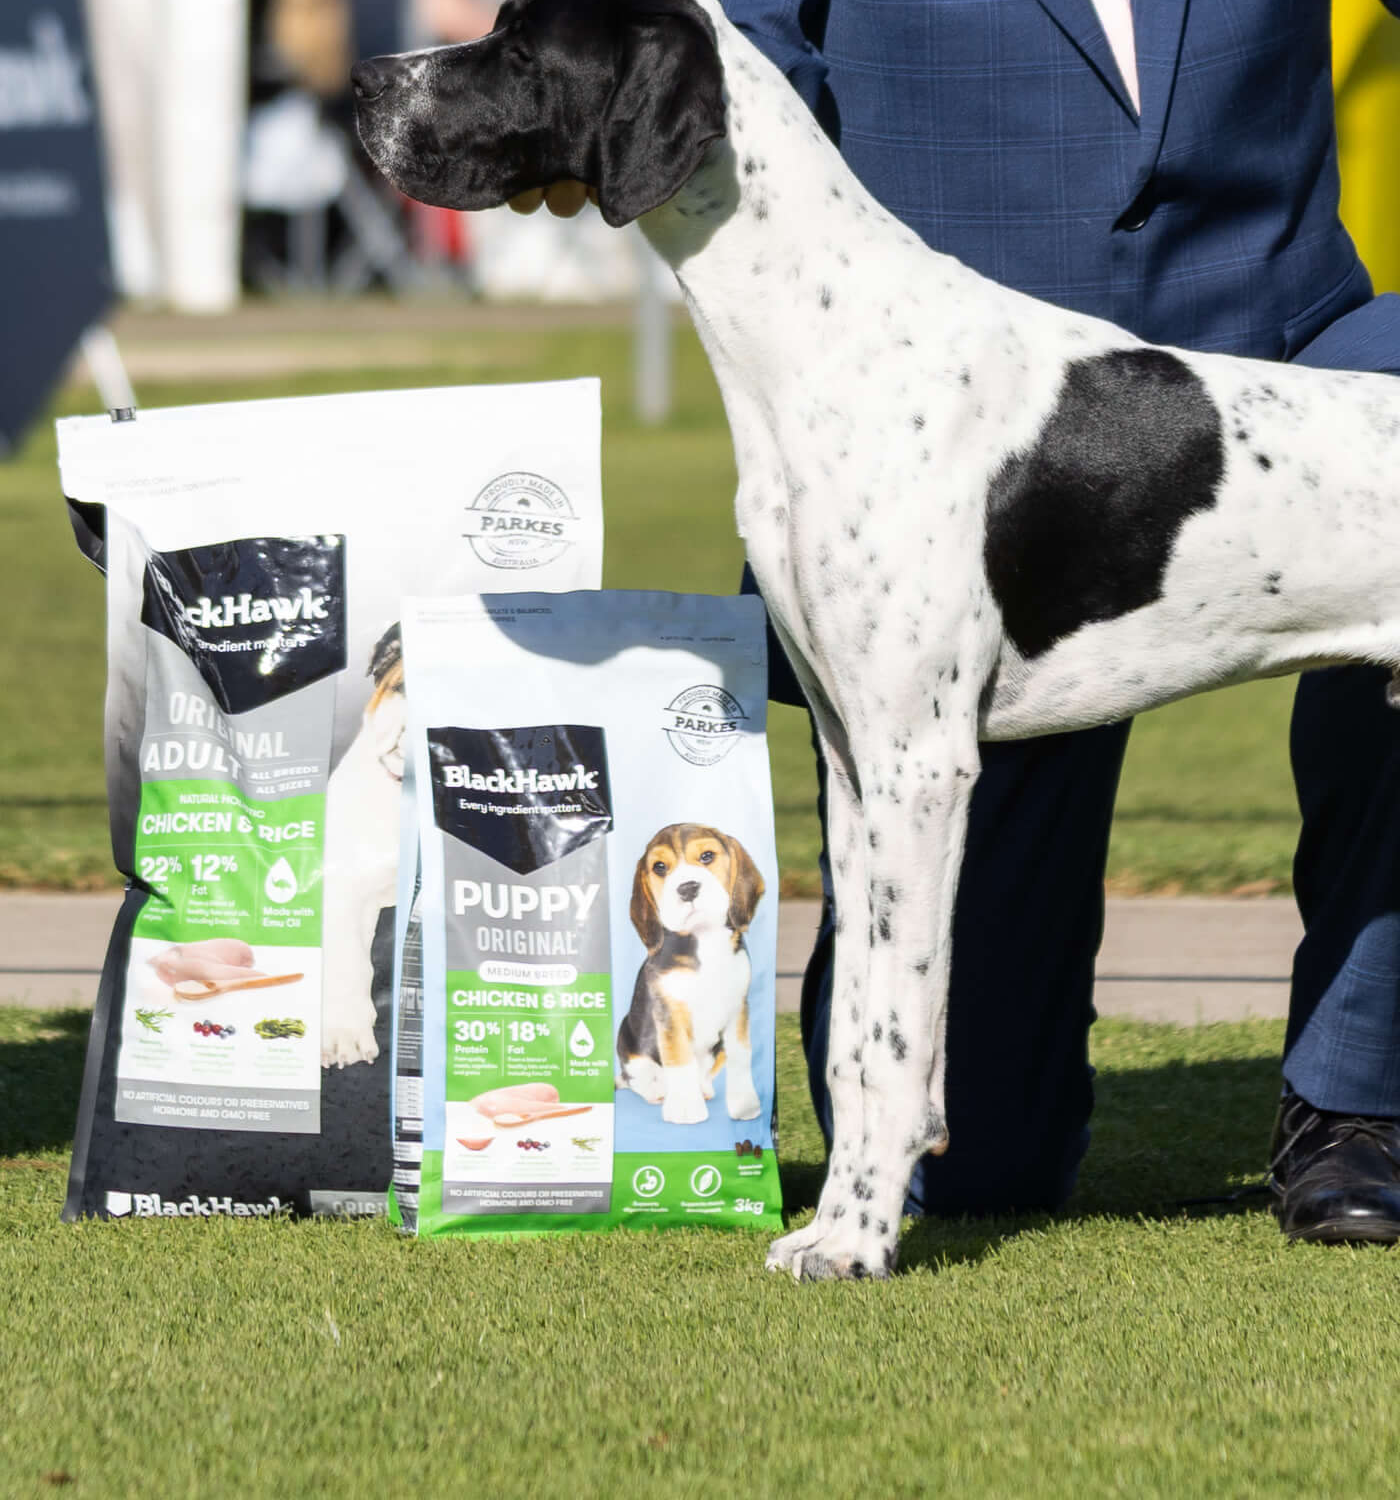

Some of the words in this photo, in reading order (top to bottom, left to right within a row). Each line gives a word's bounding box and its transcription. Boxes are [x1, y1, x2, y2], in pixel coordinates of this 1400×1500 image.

[480, 515, 565, 537] PARKES
[674, 716, 737, 734] PARKES
[143, 739, 241, 780] ADULT
[251, 769, 271, 780] ALL
[273, 765, 319, 778] BREEDS
[442, 764, 600, 794] BlackHawk
[256, 785, 276, 794] ALL
[279, 779, 312, 792] SIZES
[459, 798, 488, 814] Every
[489, 802, 539, 816] ingredient
[141, 811, 232, 835] CHICKEN
[237, 815, 253, 833] &
[258, 820, 316, 843] RICE
[139, 855, 183, 882] 22%
[191, 853, 239, 882] 12%
[191, 884, 209, 896] Fat
[453, 879, 601, 921] PUPPY
[262, 905, 290, 917] Made
[292, 906, 315, 917] with
[262, 917, 284, 928] Emu
[286, 917, 302, 928] Oil
[476, 926, 579, 956] ORIGINAL
[487, 966, 531, 979] MEDIUM
[452, 990, 539, 1009] CHICKEN
[542, 991, 556, 1009] &
[559, 991, 607, 1009] RICE
[454, 1019, 501, 1042] 30%
[507, 1019, 551, 1042] 18%
[454, 1043, 489, 1055] Protein
[507, 1044, 525, 1055] Fat
[121, 1090, 135, 1100] NO
[135, 1092, 177, 1103] ARTIFICIAL
[178, 1095, 222, 1107] COLOURS
[224, 1097, 239, 1108] OR
[240, 1098, 310, 1111] PRESERVATIVES
[152, 1105, 199, 1117] HORMONE
[200, 1108, 219, 1118] AND
[221, 1110, 245, 1120] GMO
[247, 1111, 271, 1121] FREE
[733, 1197, 765, 1216] 3kg
